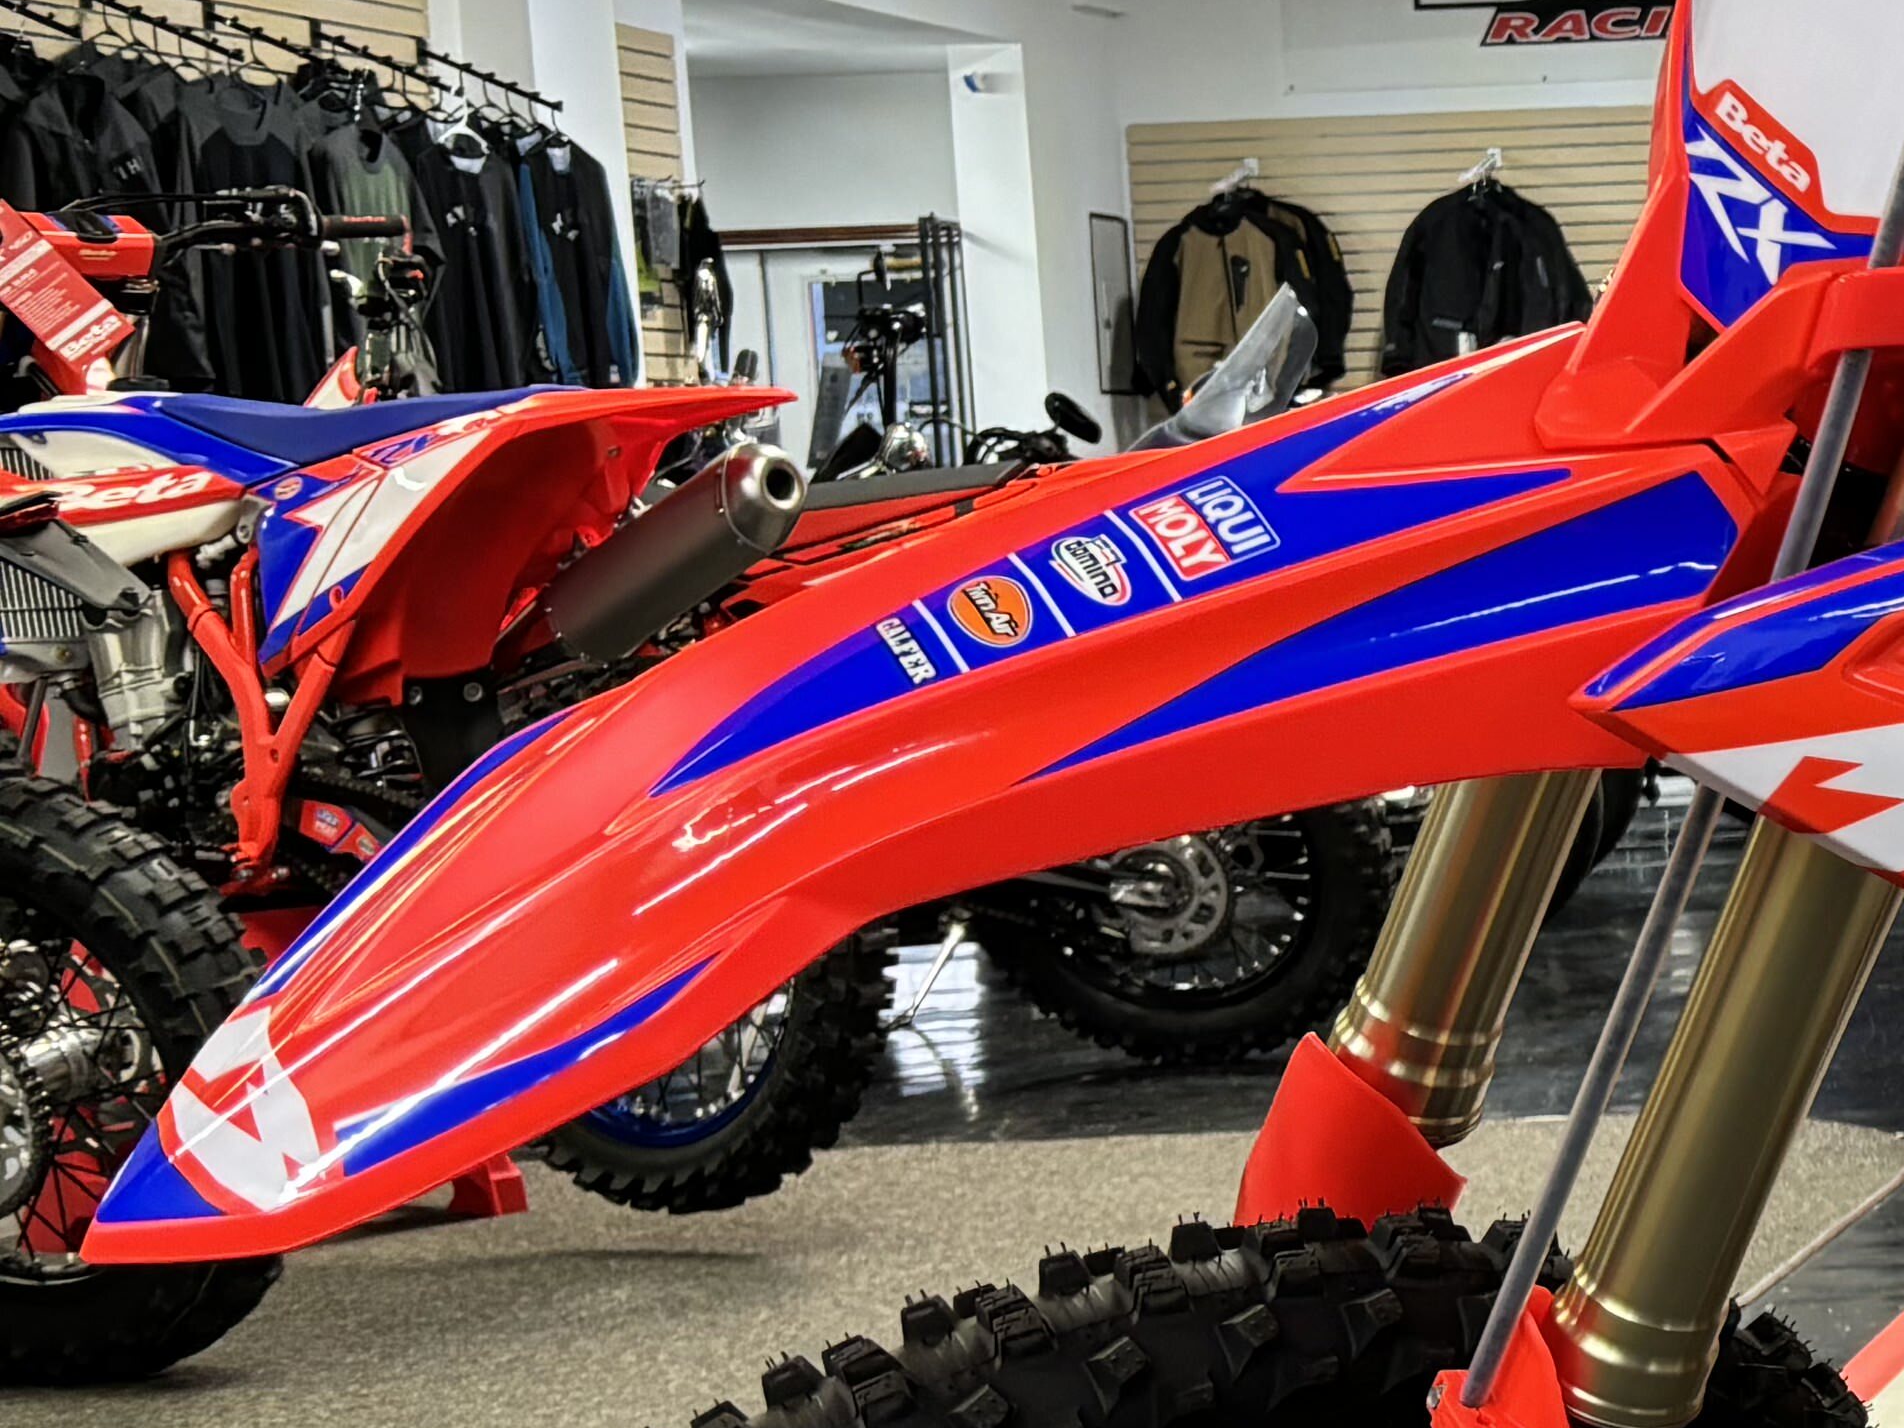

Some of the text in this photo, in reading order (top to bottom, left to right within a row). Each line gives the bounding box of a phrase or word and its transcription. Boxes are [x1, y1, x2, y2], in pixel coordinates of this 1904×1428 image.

[1485, 6, 1674, 44] RACI
[1714, 90, 1812, 193] Beta
[1138, 497, 1228, 568] MOLY
[1187, 477, 1271, 556] LIQUI
[1065, 537, 1120, 599] domino
[876, 616, 938, 686] GALFER
[983, 606, 1019, 639] Air
